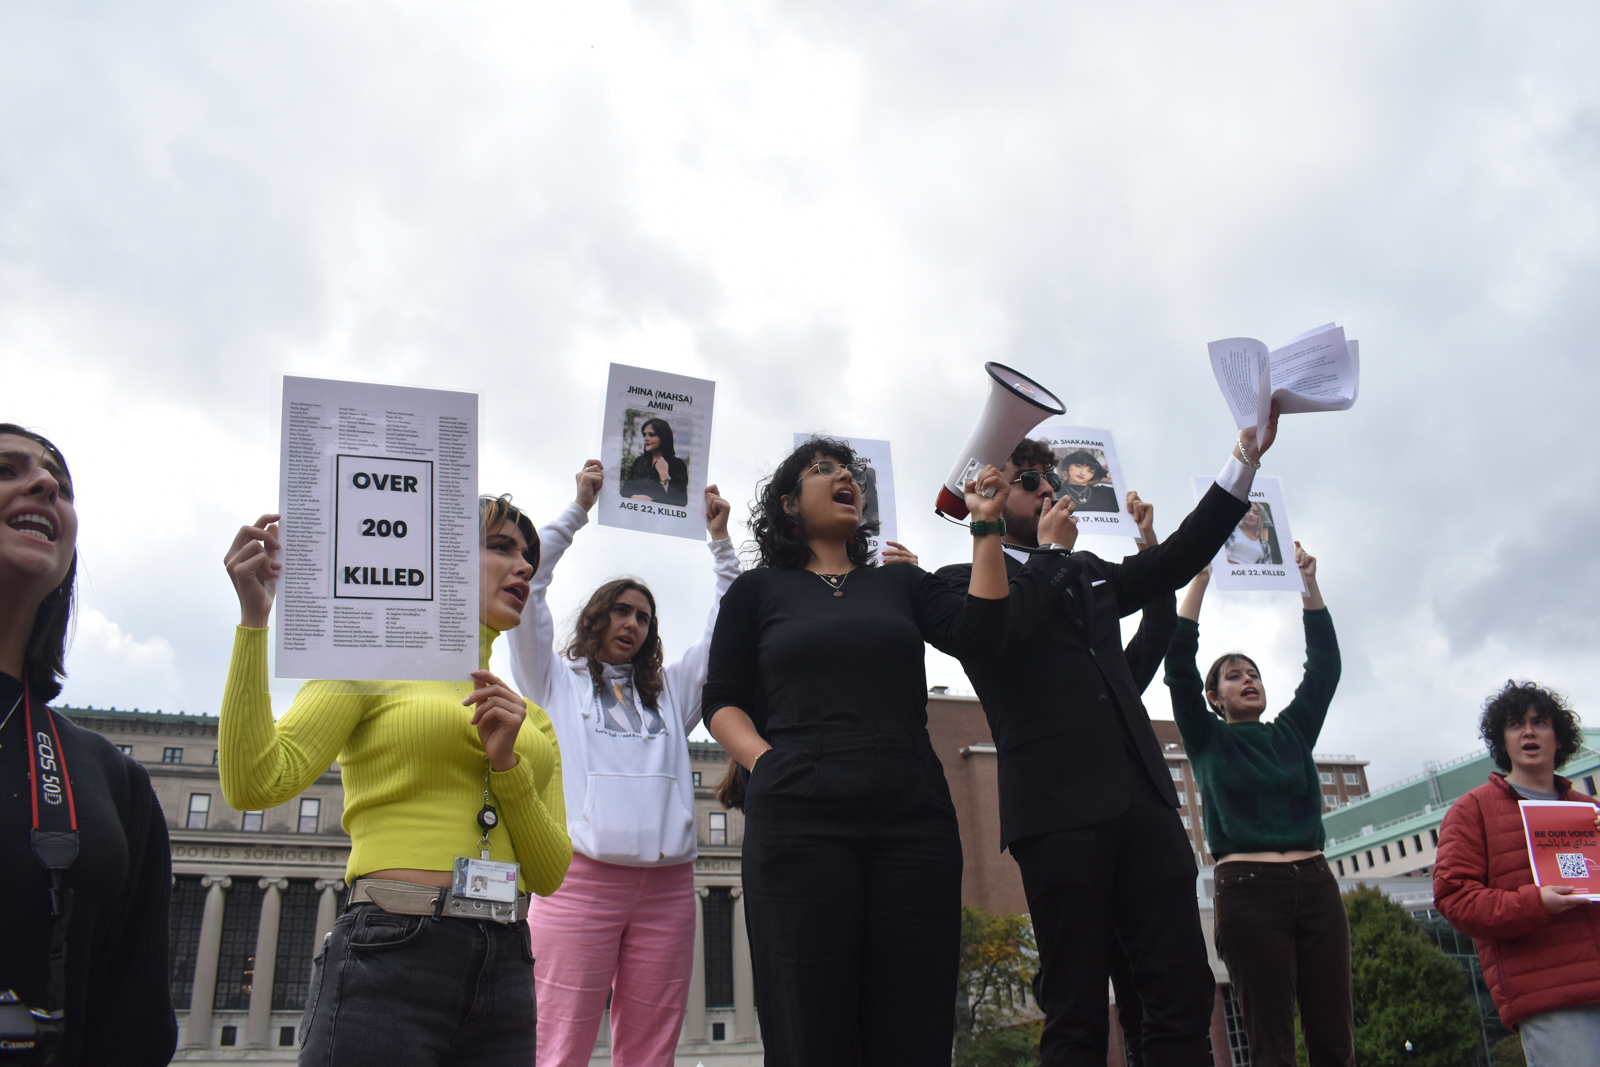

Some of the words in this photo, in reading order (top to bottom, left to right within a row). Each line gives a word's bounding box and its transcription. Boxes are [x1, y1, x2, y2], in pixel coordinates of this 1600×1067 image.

[627, 386, 653, 397] JHINA
[655, 390, 693, 405] (MAHSA)
[647, 400, 674, 411] AMINI
[352, 472, 418, 493] OVER
[619, 501, 639, 511] AGE
[640, 504, 656, 515] 22,
[658, 507, 687, 519] KILLED
[362, 518, 408, 538] 200
[344, 566, 425, 586] KILLED
[36, 732, 57, 771] EOS
[42, 774, 63, 805] 50D
[172, 846, 231, 858] DOTUS
[243, 849, 336, 862] SOPHOCLES
[695, 860, 734, 871] ERGIL
[0, 1040, 35, 1049] Canon
